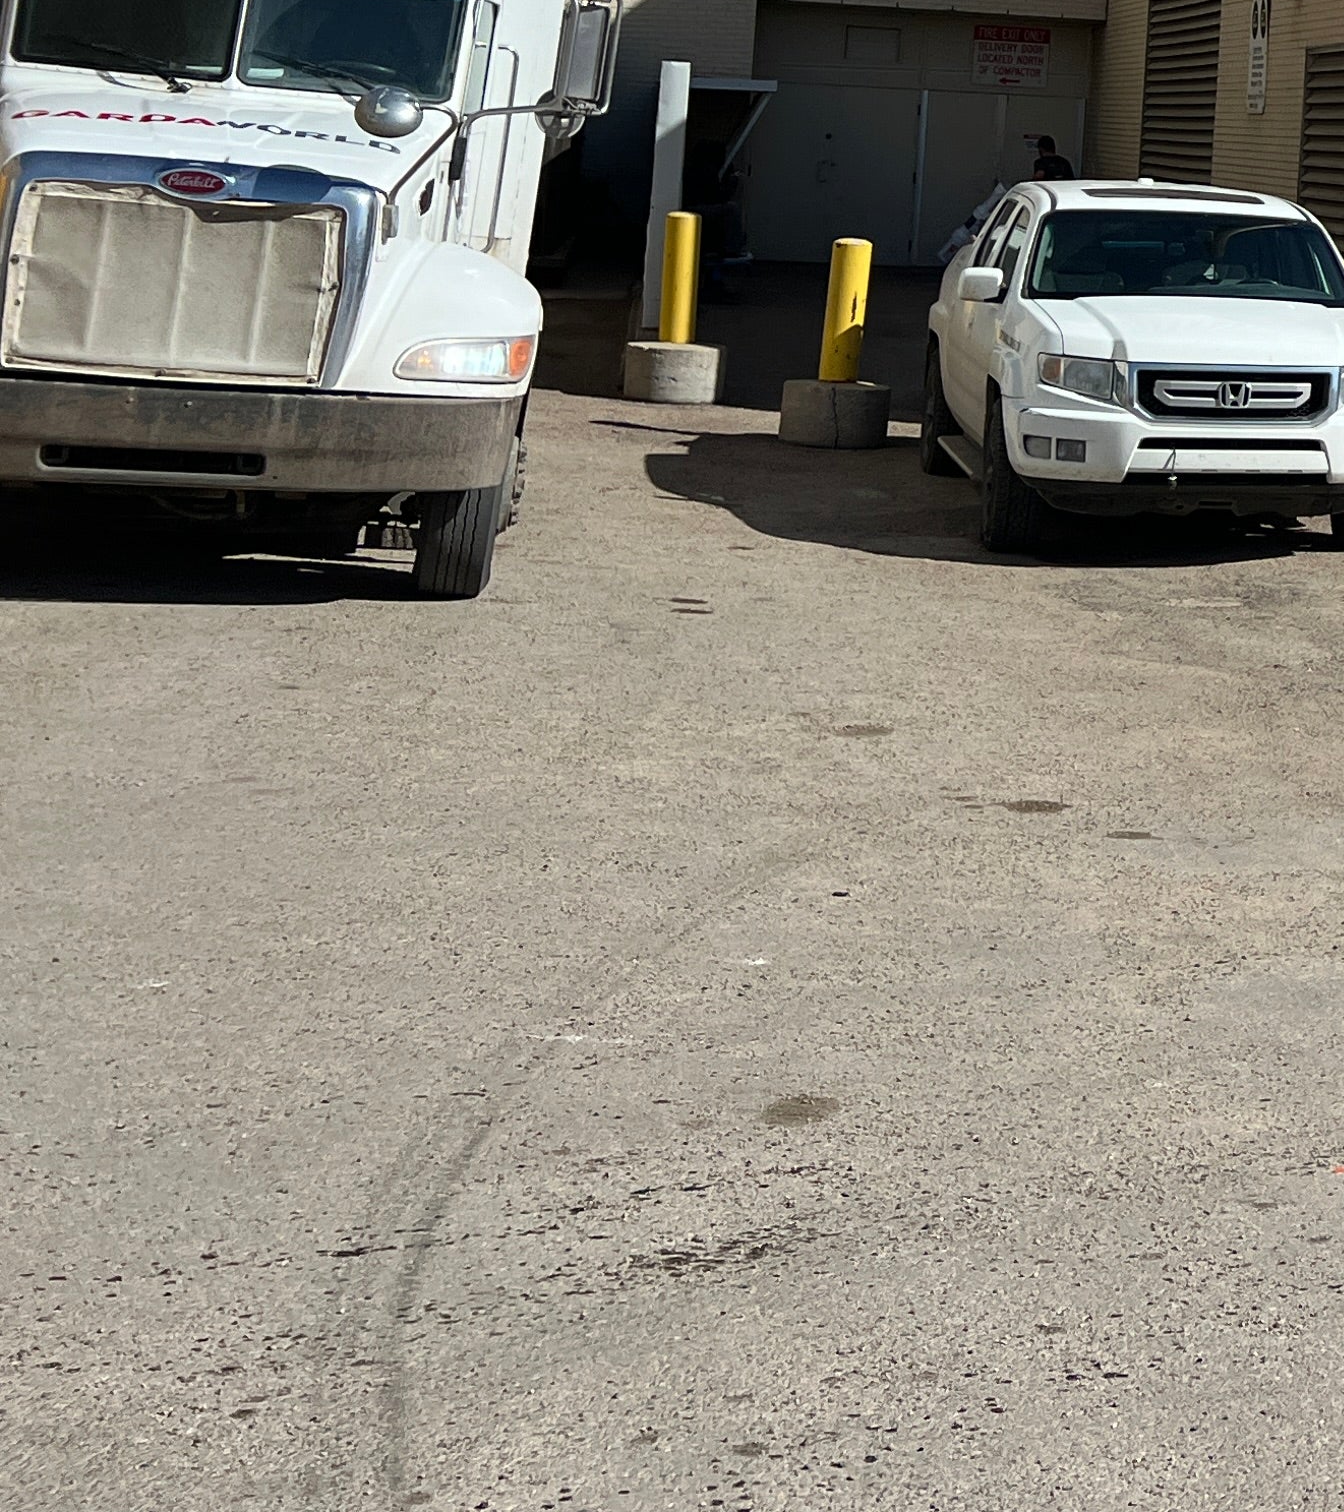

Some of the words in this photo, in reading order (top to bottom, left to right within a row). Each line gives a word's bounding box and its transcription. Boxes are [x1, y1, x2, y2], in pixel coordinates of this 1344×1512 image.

[979, 26, 998, 39] FIRE
[1002, 28, 1020, 40] EXIT
[1024, 29, 1046, 41] ONLY
[11, 110, 401, 155] GARDAWORLD
